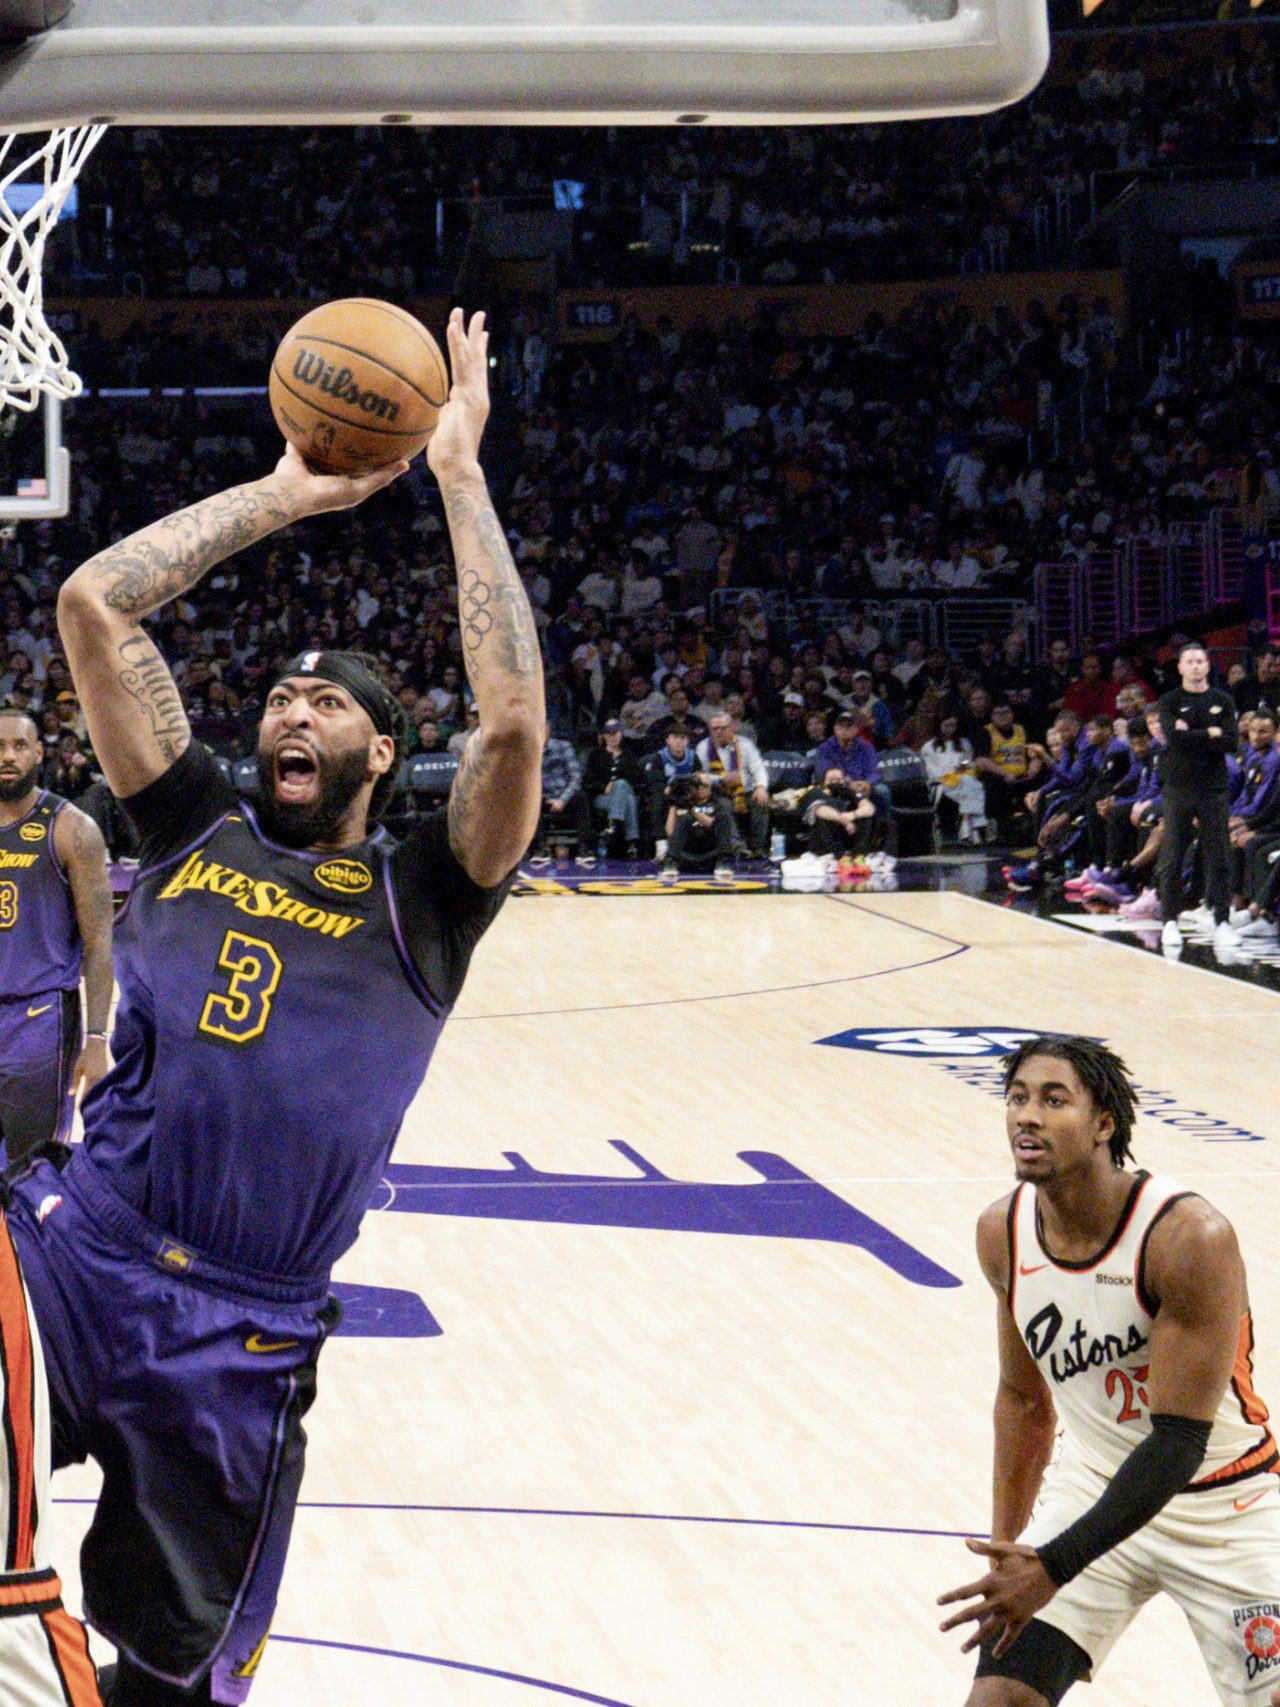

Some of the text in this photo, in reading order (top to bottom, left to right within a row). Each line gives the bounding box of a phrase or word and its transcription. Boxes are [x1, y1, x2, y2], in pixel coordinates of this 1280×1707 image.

[293, 350, 400, 421] Wilson
[887, 756, 920, 767] DELTA
[319, 865, 369, 885] bibigo
[199, 929, 283, 1043] 3
[1095, 1273, 1134, 1286] StockX
[1024, 1302, 1148, 1384] Pistons
[1233, 1603, 1280, 1627] PISTON
